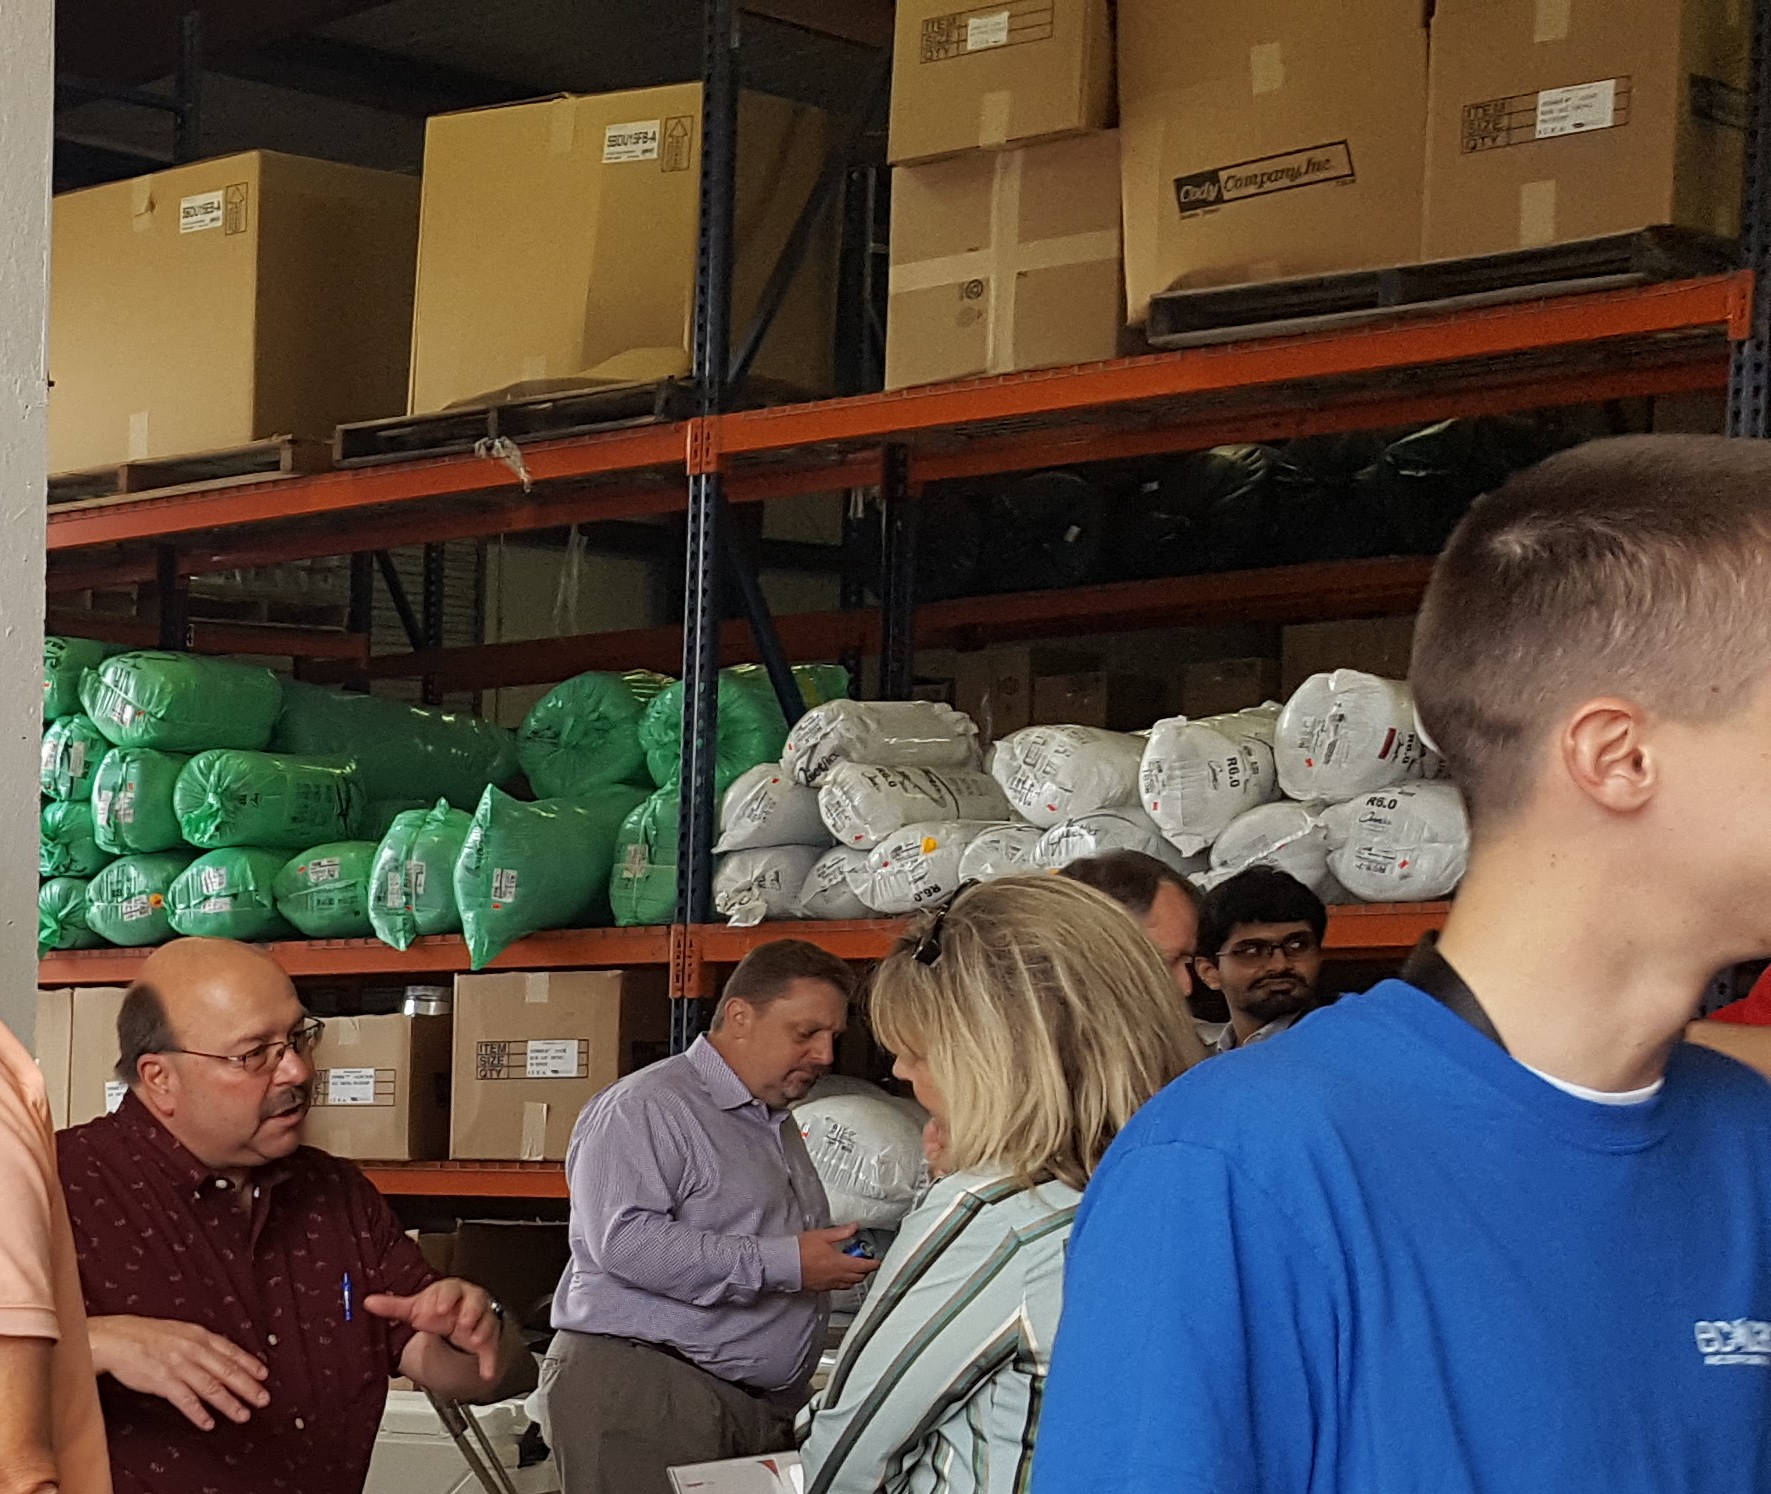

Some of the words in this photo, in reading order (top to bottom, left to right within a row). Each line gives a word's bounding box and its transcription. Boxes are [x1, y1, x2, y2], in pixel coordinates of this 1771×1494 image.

[1366, 796, 1398, 811] R6.0
[479, 1042, 507, 1054] ITEM
[479, 1055, 506, 1067] SIZE
[479, 1068, 504, 1079] QTY
